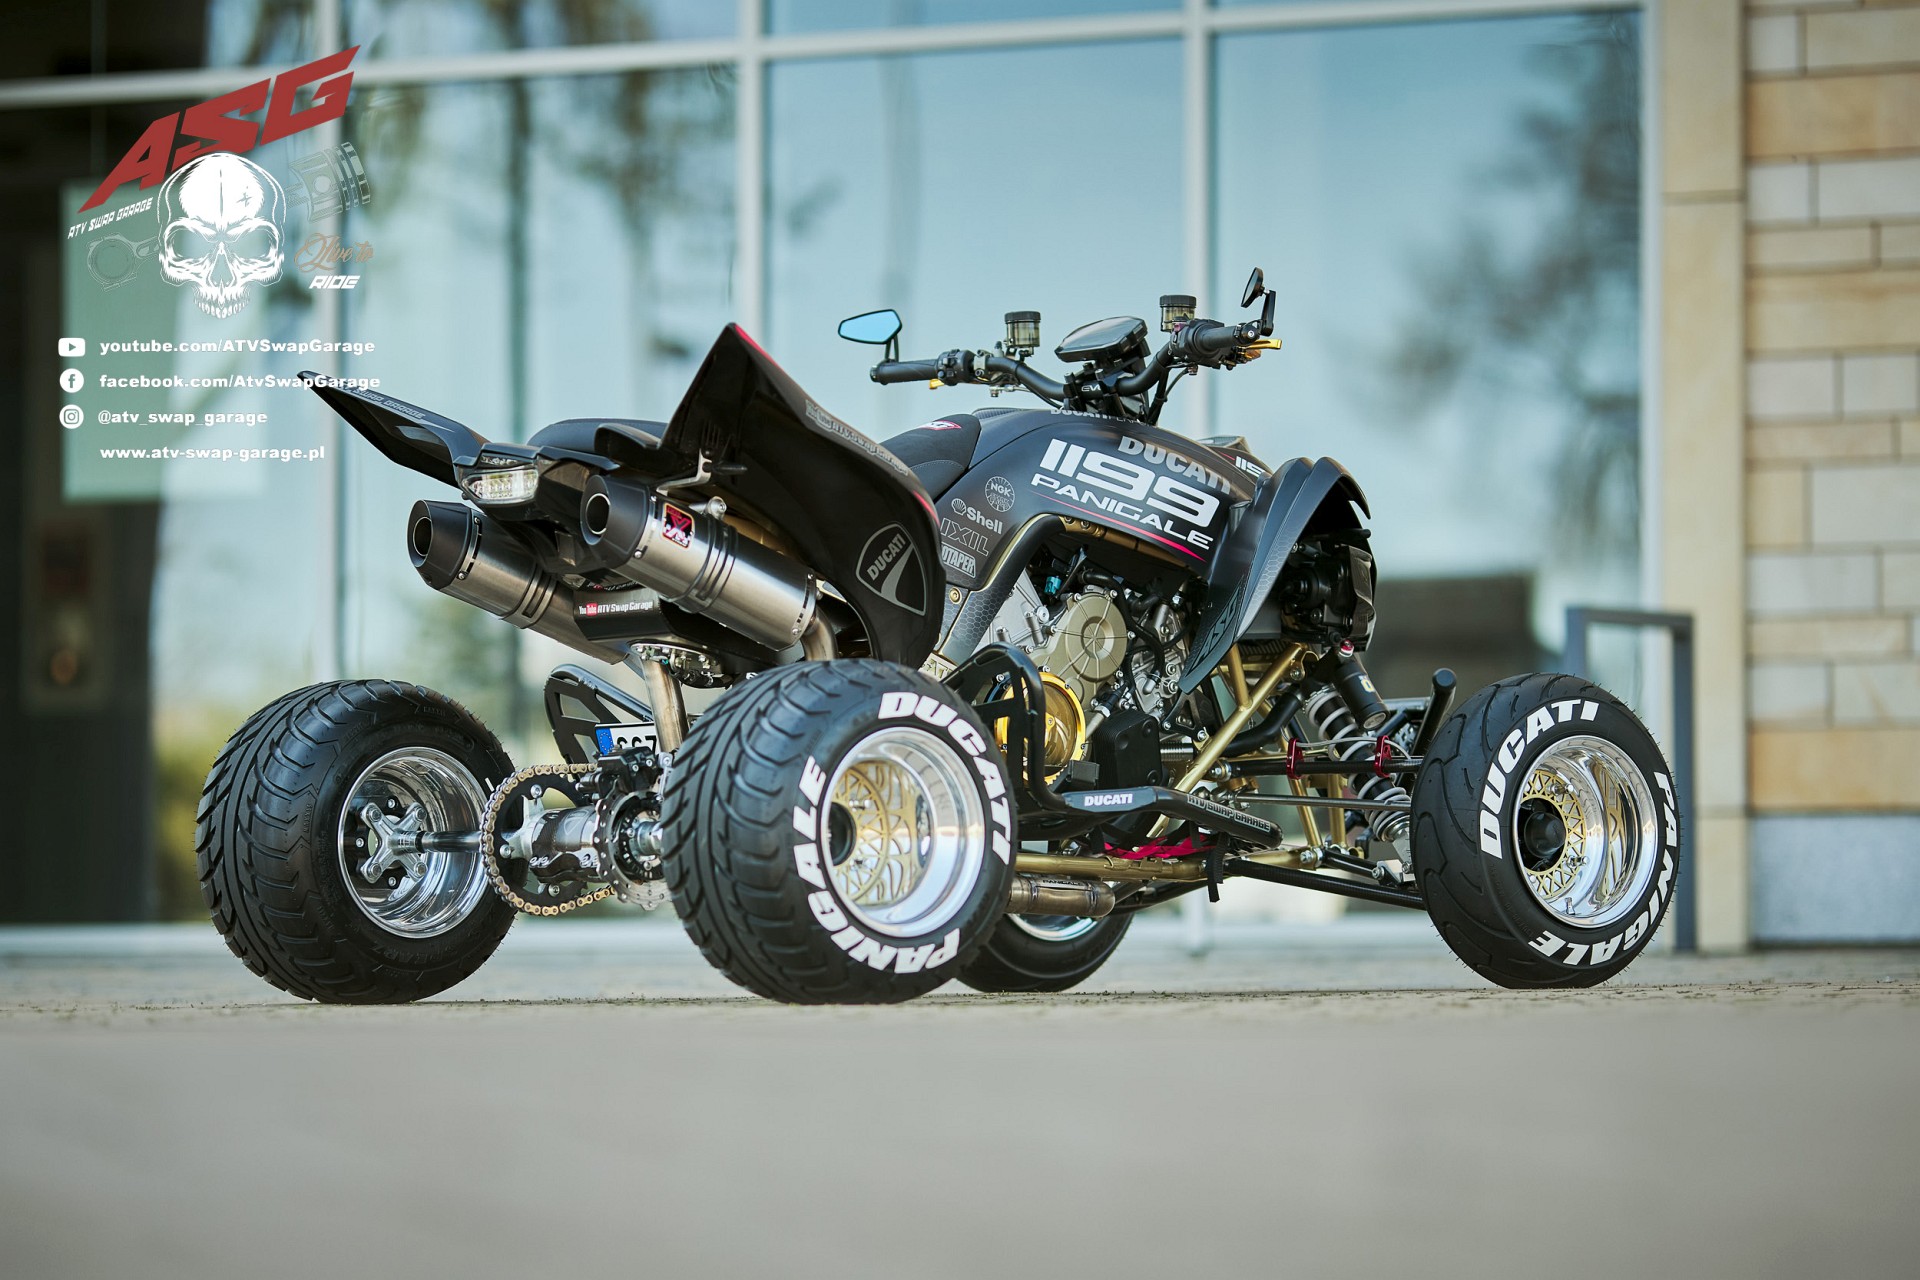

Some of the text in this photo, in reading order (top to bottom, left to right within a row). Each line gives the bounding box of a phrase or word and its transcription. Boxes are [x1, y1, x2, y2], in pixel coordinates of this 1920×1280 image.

[990, 482, 1012, 497] NGK
[1039, 438, 1220, 528] 1199
[1117, 435, 1231, 495] DUCATI
[940, 517, 989, 557] IXIL
[967, 506, 1004, 535] Shell
[1030, 473, 1214, 550] PANIGALE
[866, 533, 907, 581] DUCATI
[610, 603, 629, 613] Swap
[629, 601, 653, 612] Garage
[877, 691, 1013, 866] DUCATI
[1084, 793, 1133, 807] DUCATI
[1479, 698, 1600, 860] DUCATI
[1206, 801, 1234, 819] SWAP
[1234, 810, 1271, 833] GARAGE
[793, 755, 961, 974] PANIGALE
[1527, 770, 1678, 967] PANIGALE
